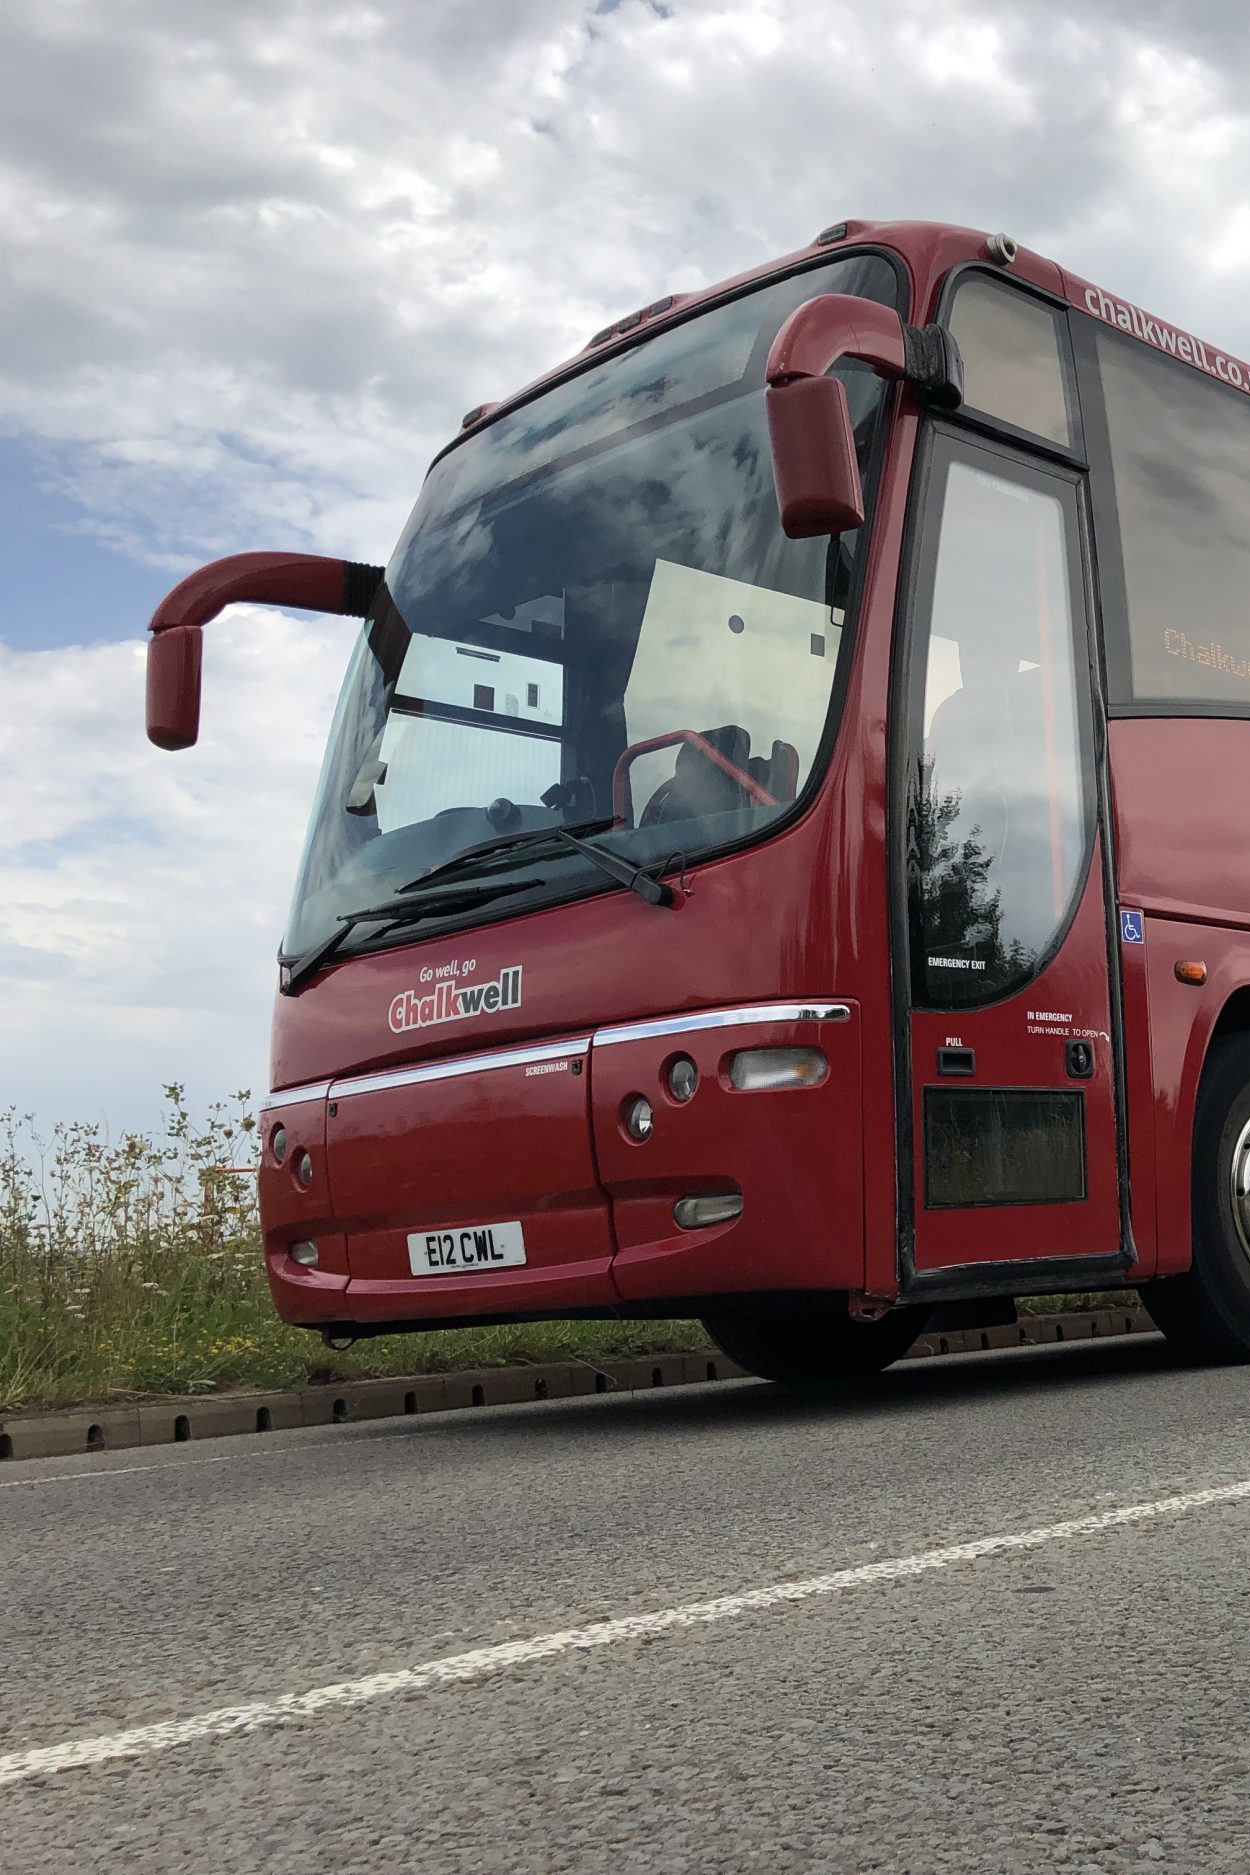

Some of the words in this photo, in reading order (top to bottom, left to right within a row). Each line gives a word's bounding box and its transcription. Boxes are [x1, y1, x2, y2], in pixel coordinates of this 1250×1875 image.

[419, 966, 433, 983] Go
[435, 959, 460, 978] well,
[462, 958, 476, 977] go
[928, 956, 970, 969] EMERGENCY
[971, 960, 986, 970] EXIT
[388, 965, 523, 1034] Chalkwell
[1027, 1011, 1035, 1020] IN
[1035, 1011, 1073, 1023] EMERGENCY
[1027, 1025, 1045, 1035] TURN
[1045, 1026, 1070, 1036] HANDLE
[1072, 1028, 1081, 1037] TO
[1082, 1028, 1099, 1038] OPEN
[945, 1037, 963, 1047] PULL
[525, 1061, 568, 1077] SCREENWASH
[425, 1234, 457, 1267] E12
[460, 1229, 504, 1263] CWL
